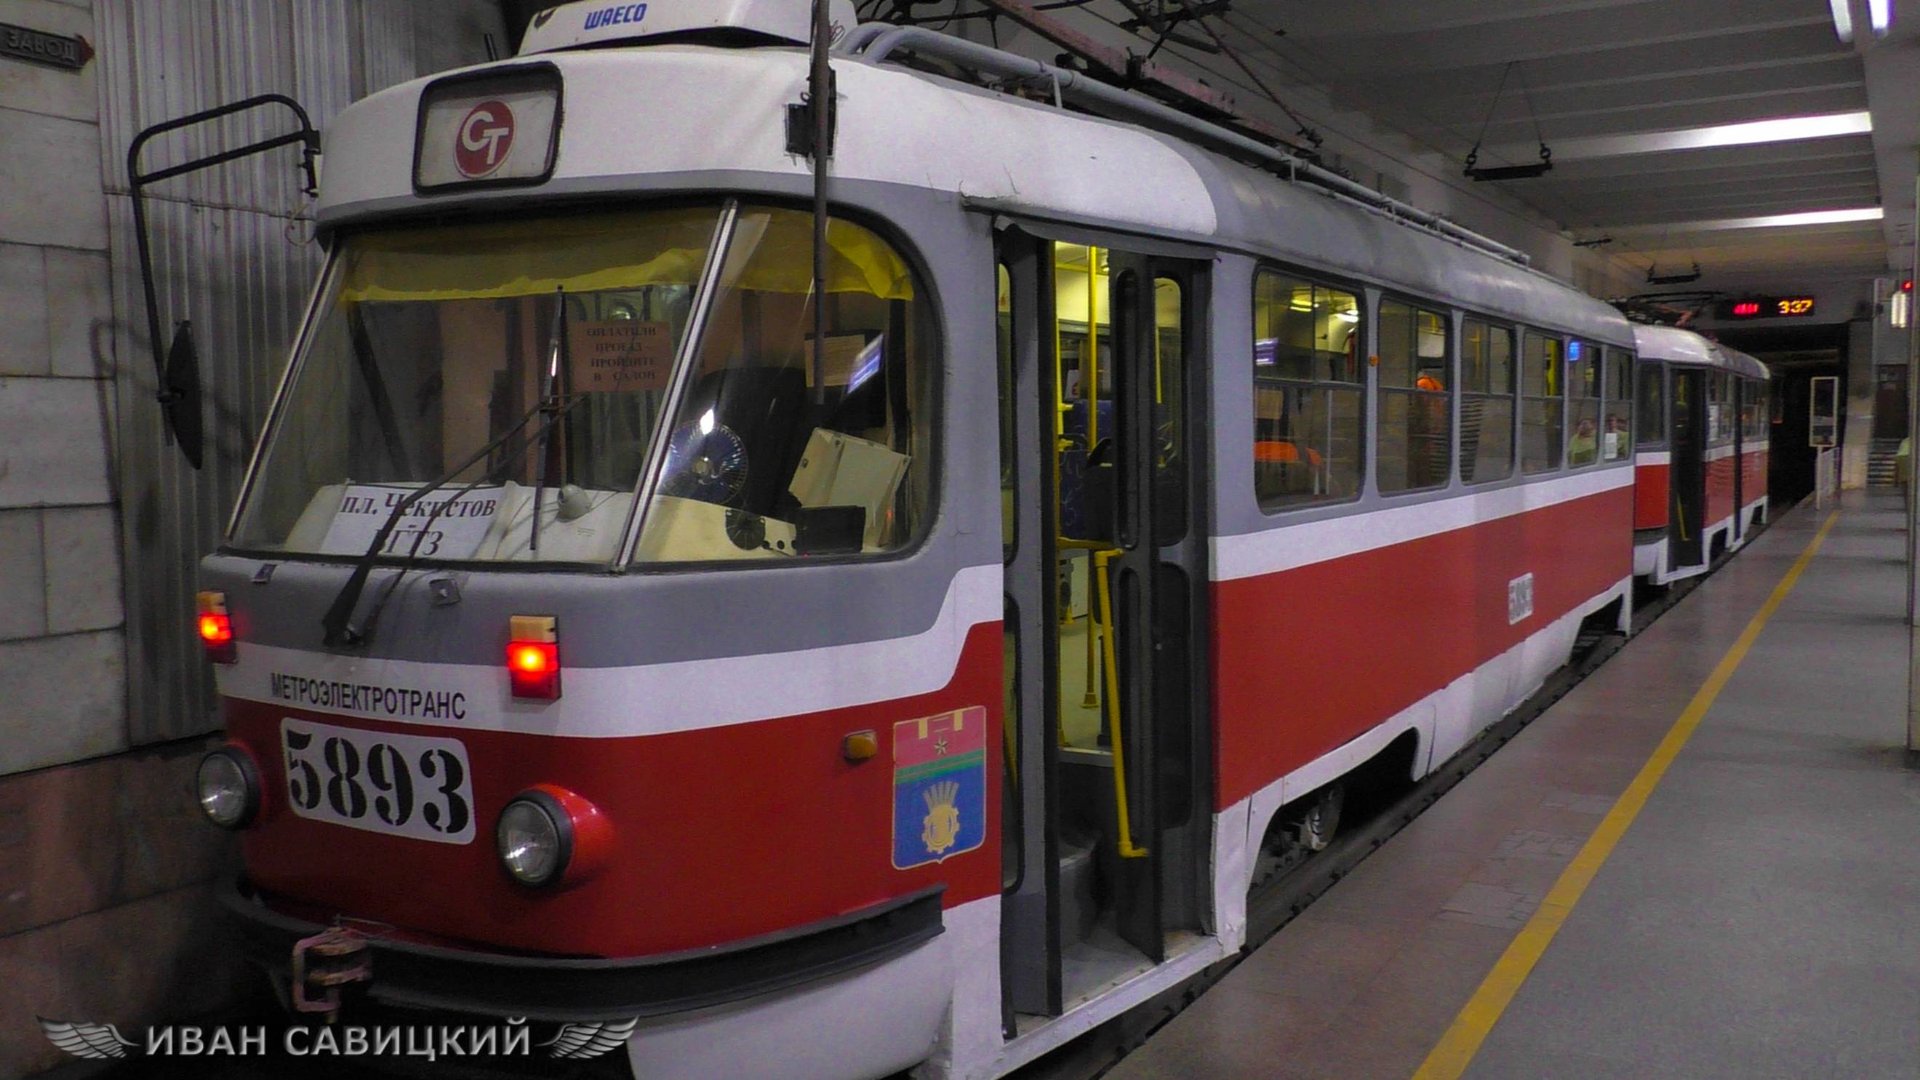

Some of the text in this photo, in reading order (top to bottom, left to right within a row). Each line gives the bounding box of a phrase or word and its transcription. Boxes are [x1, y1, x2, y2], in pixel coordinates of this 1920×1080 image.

[584, 3, 647, 30] WAECO
[7, 30, 76, 63] ЗАВОД
[271, 672, 466, 720] МЕТРОЭЛЕКТРОТРАНС
[286, 729, 470, 834] 5893
